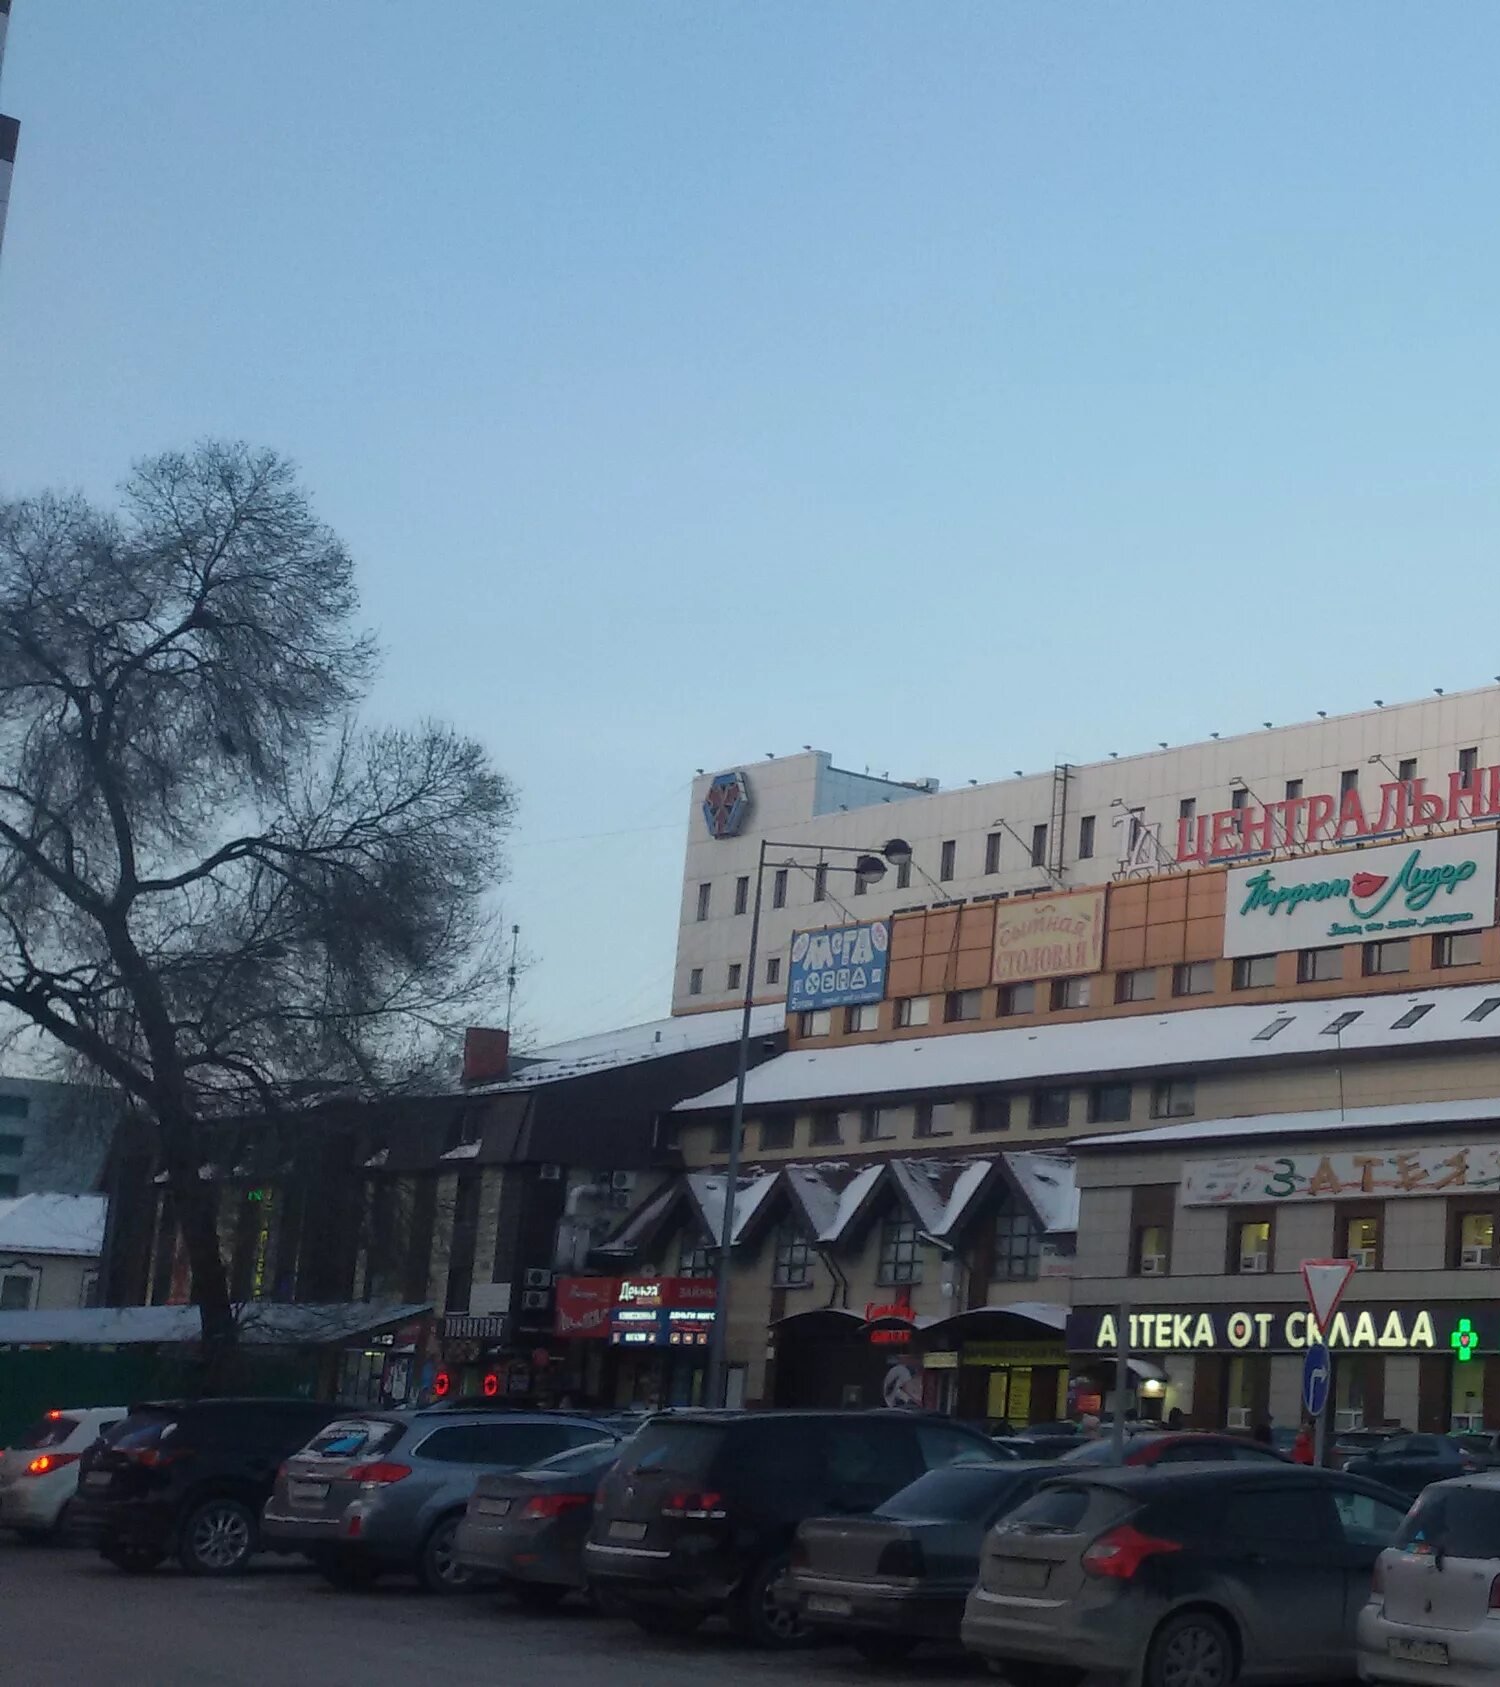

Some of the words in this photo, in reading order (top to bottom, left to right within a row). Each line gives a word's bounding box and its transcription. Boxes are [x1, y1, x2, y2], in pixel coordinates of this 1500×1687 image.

[1362, 849, 1477, 918] Лидер
[1227, 1312, 1275, 1348] ОТ
[1285, 1311, 1436, 1348] СКЛАДА
